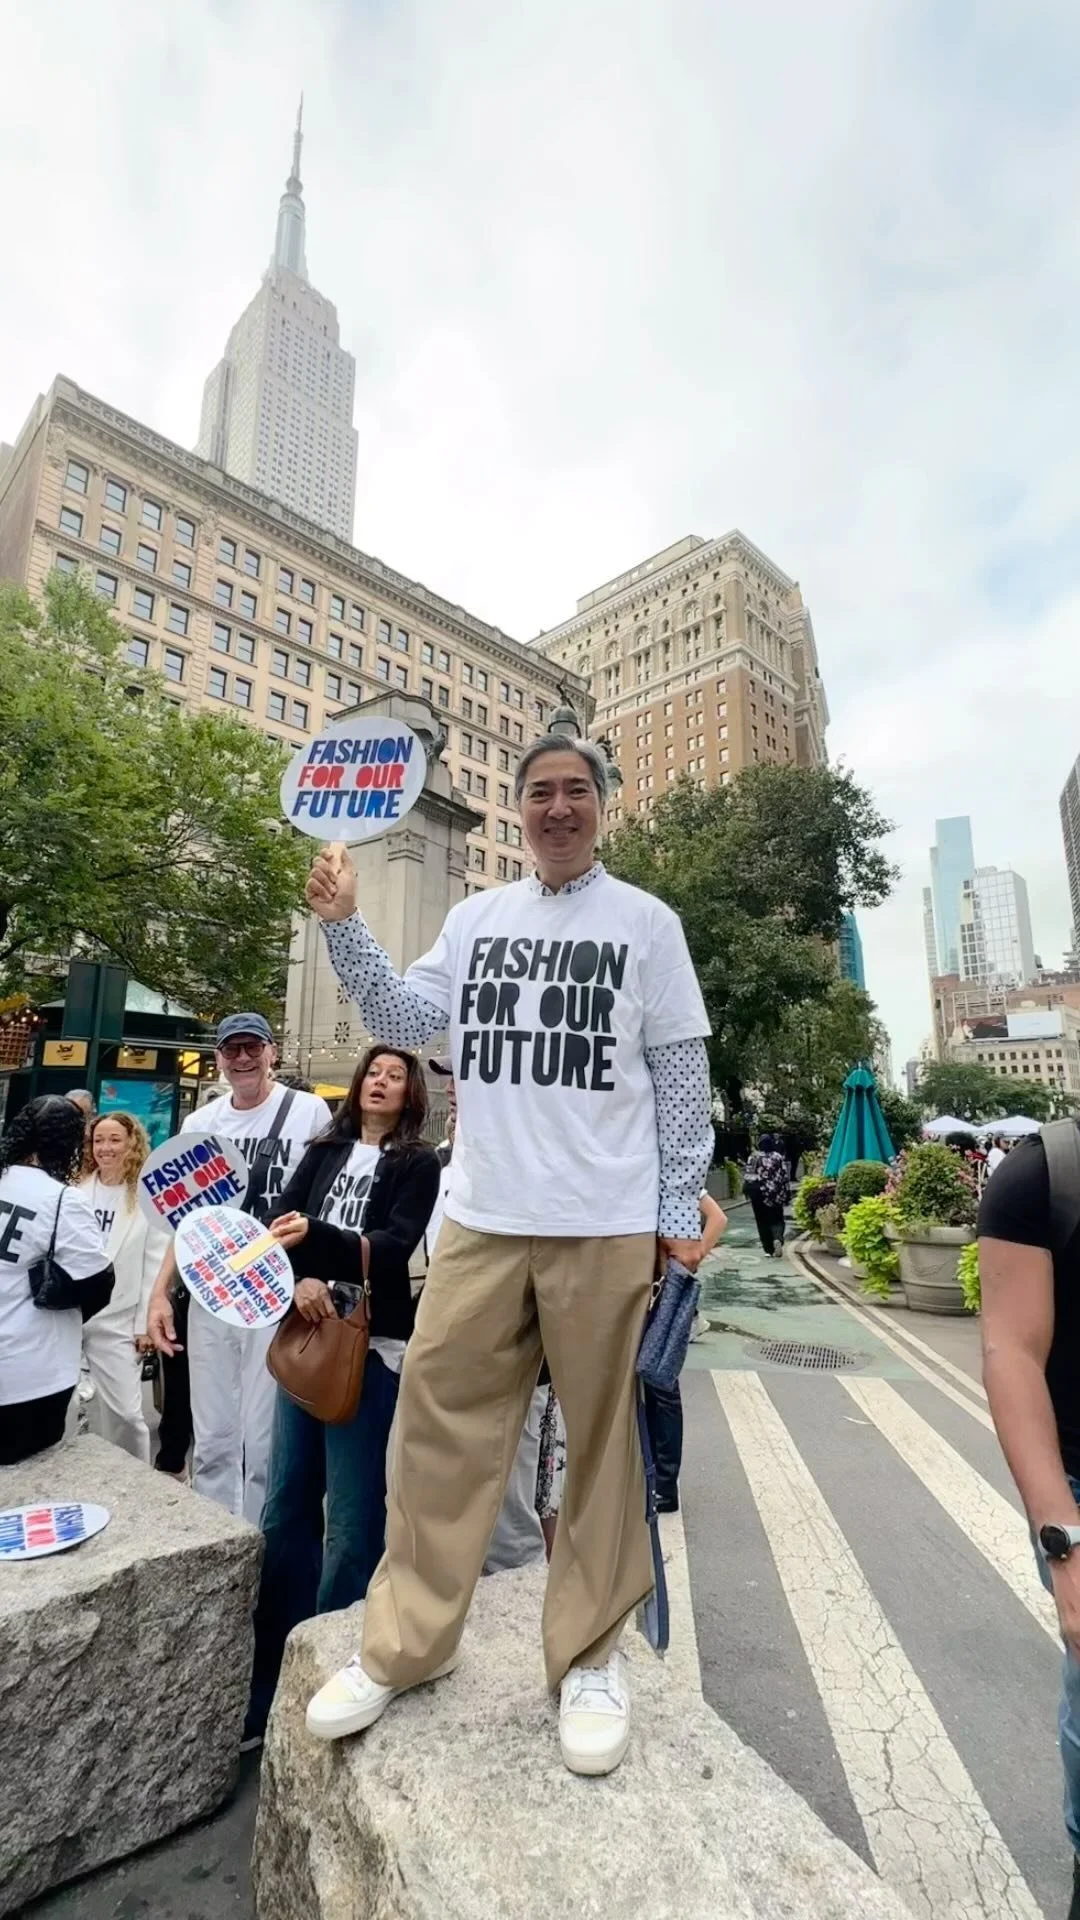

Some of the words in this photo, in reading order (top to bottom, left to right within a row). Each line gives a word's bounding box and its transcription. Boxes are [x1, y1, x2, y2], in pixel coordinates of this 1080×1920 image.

[308, 736, 413, 764] FASHION
[297, 766, 344, 788] FOR
[356, 764, 405, 788] OUR
[292, 789, 403, 818] FUTURE
[468, 937, 629, 990] FASHION
[460, 982, 520, 1026] FOR
[540, 985, 615, 1033] OUR
[460, 1030, 617, 1091] FUTURE
[142, 1136, 223, 1196] FASHION
[152, 1182, 191, 1215] FOR
[193, 1155, 231, 1188] OUR
[181, 1262, 224, 1313] FASHION
[202, 1250, 243, 1299] FUTURE
[236, 1272, 274, 1318] FASHION
[253, 1259, 291, 1305] FUTURE
